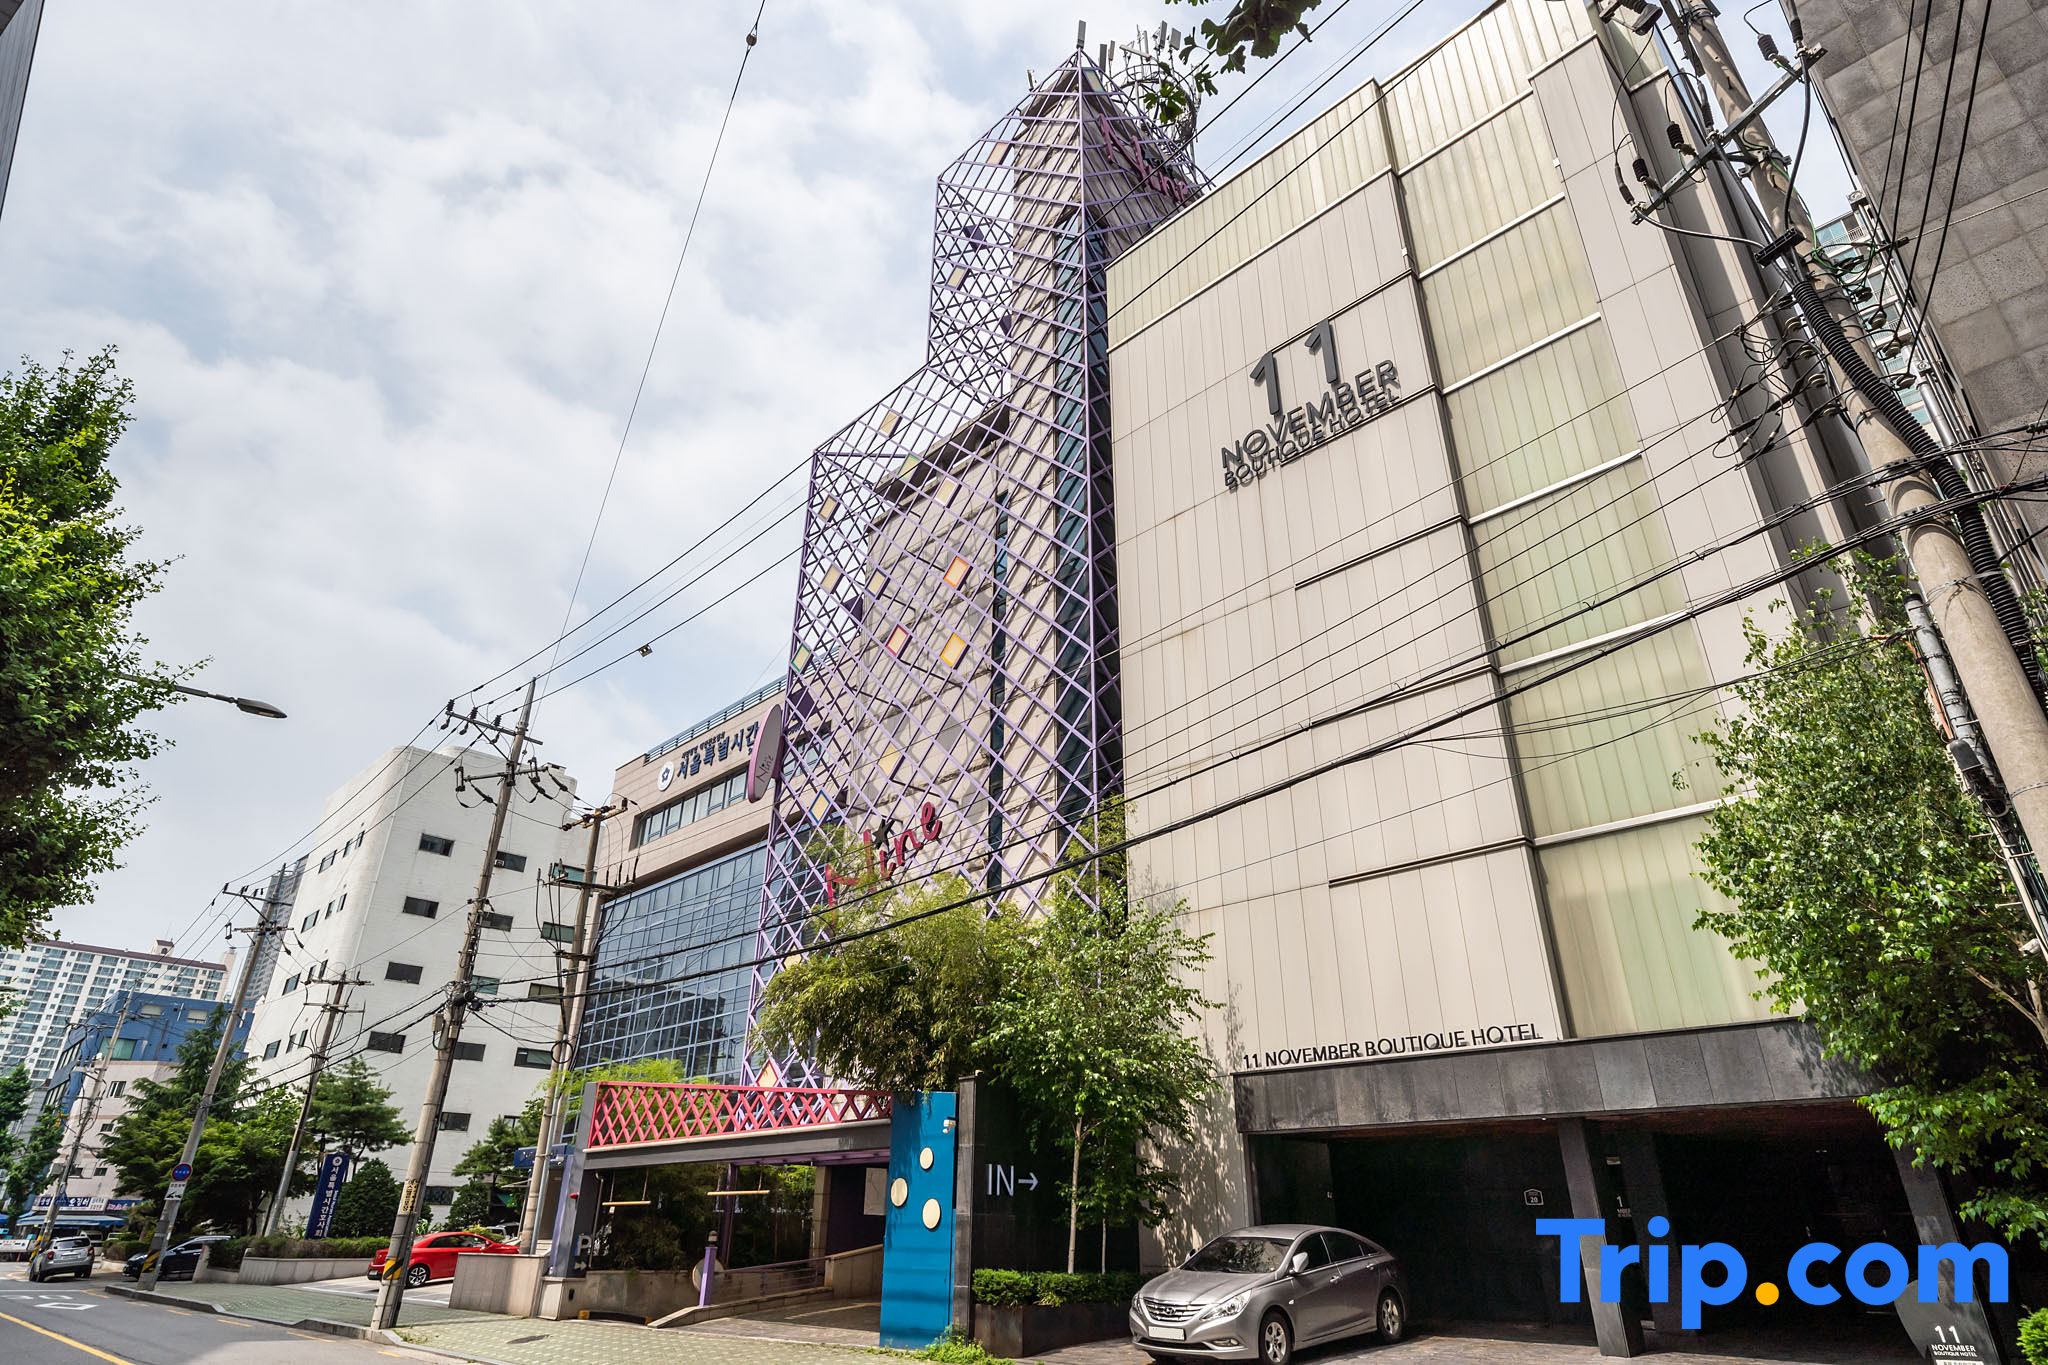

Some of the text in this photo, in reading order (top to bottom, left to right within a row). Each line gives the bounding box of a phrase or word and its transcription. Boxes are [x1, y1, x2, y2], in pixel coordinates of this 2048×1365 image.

[1250, 319, 1338, 416] 11
[1221, 360, 1397, 468] NOVEMBER
[1224, 388, 1400, 487] BOUTIQUE HOTEL
[1243, 1023, 1544, 1069] 11 NOVEMBER BOUTIQUE HOTEL
[987, 1163, 1014, 1197] IN
[1931, 1344, 1976, 1352] NOVEMBER
[1934, 1325, 1961, 1344] 11
